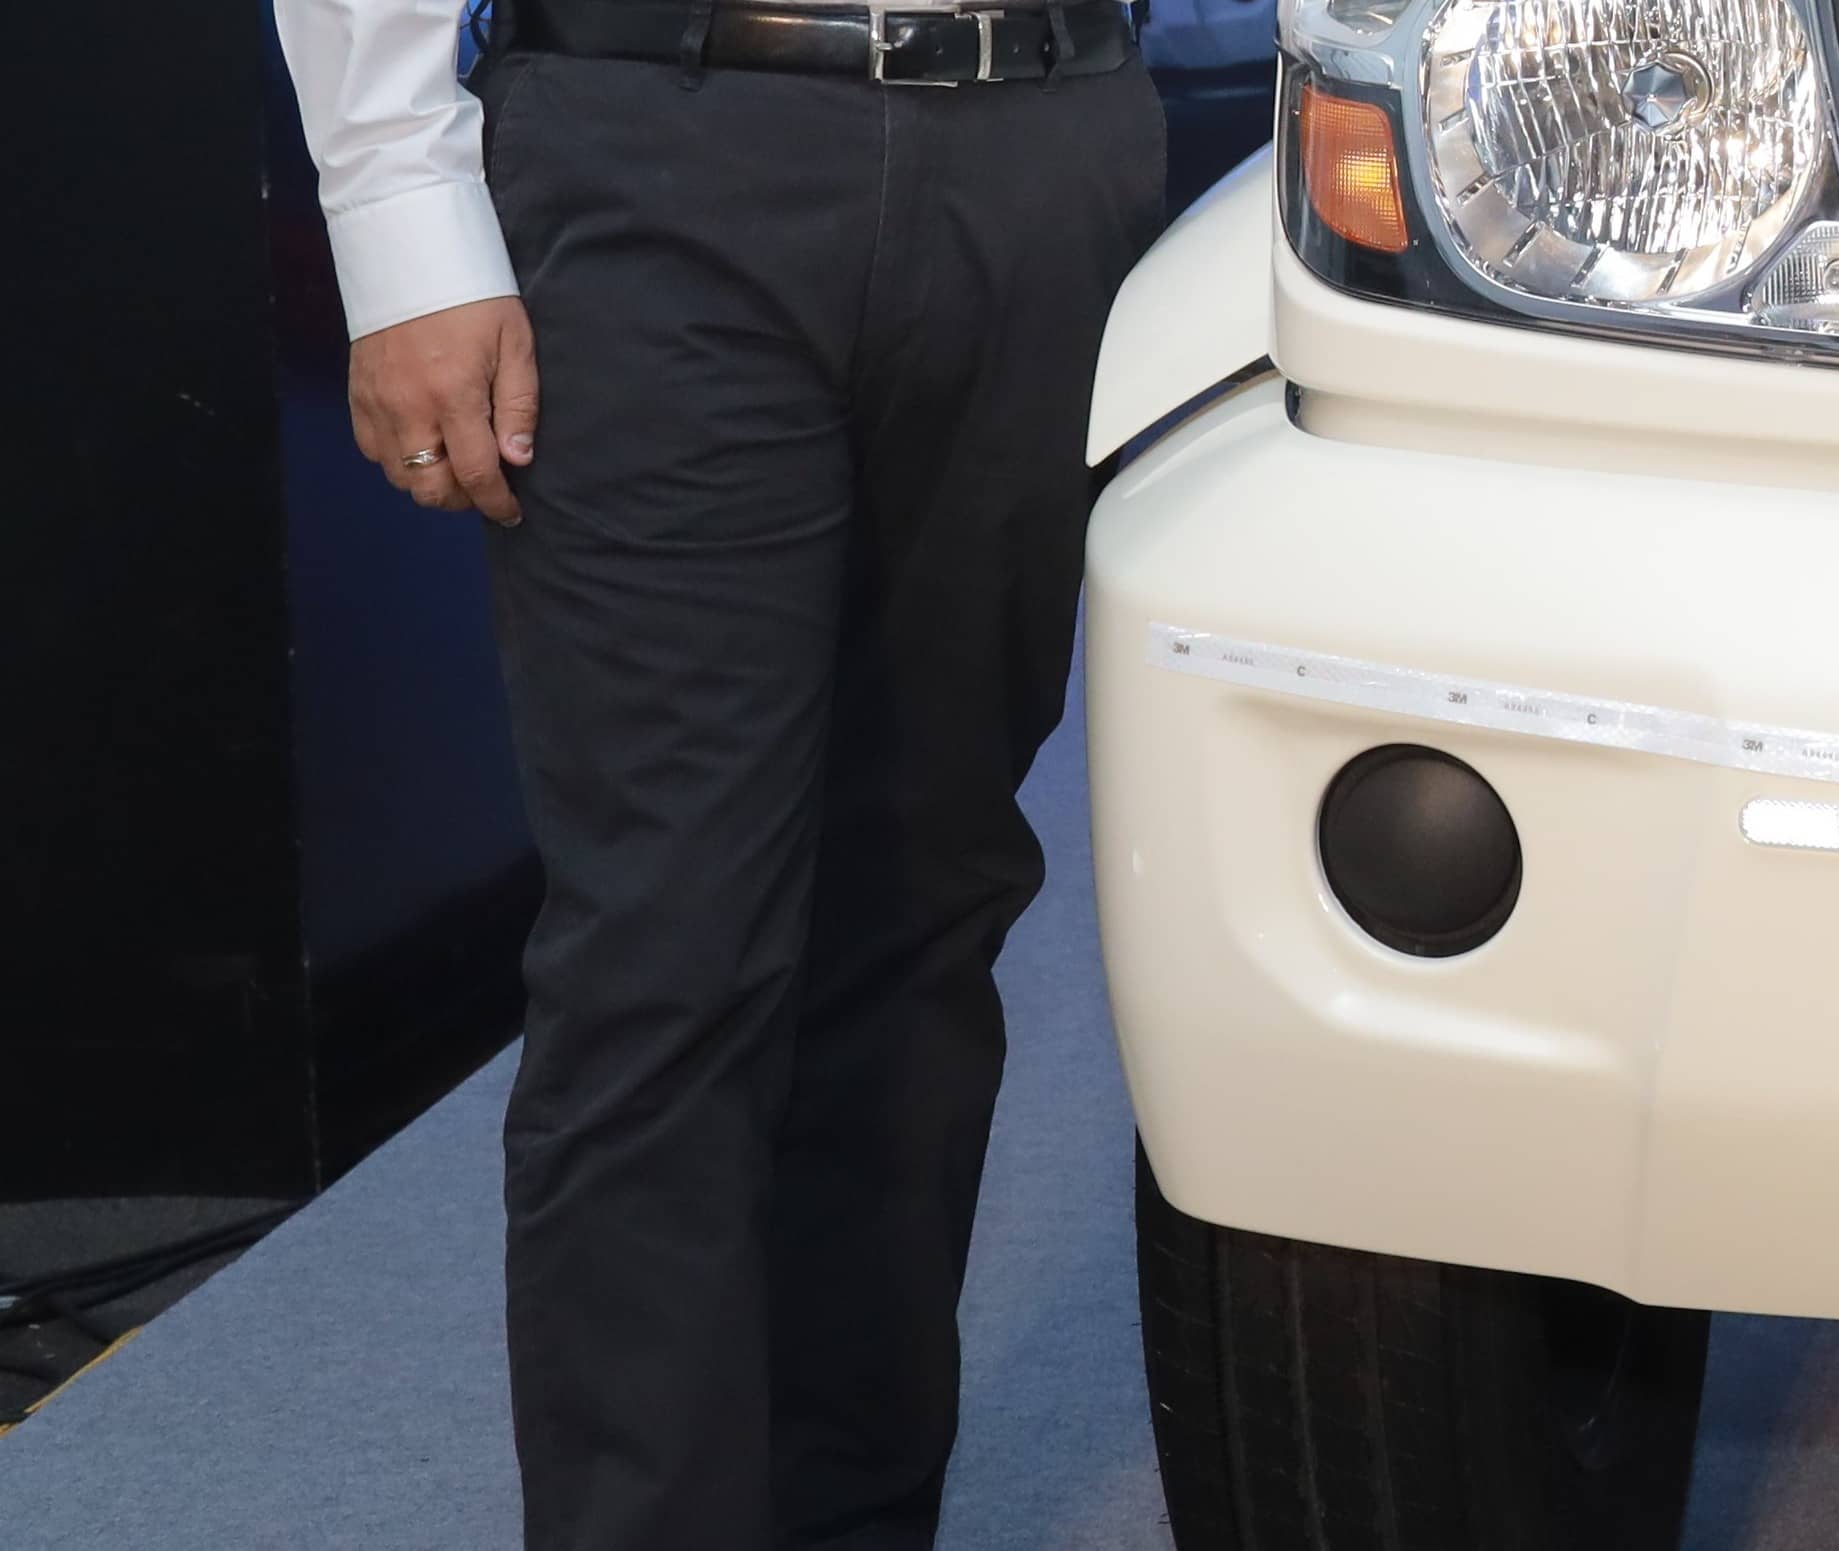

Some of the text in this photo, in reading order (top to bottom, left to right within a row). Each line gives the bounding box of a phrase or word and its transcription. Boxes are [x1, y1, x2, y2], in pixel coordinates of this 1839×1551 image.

[1173, 641, 1306, 677] 3M C
[1447, 691, 1597, 725] 3M C
[1742, 738, 1763, 752] 3M
